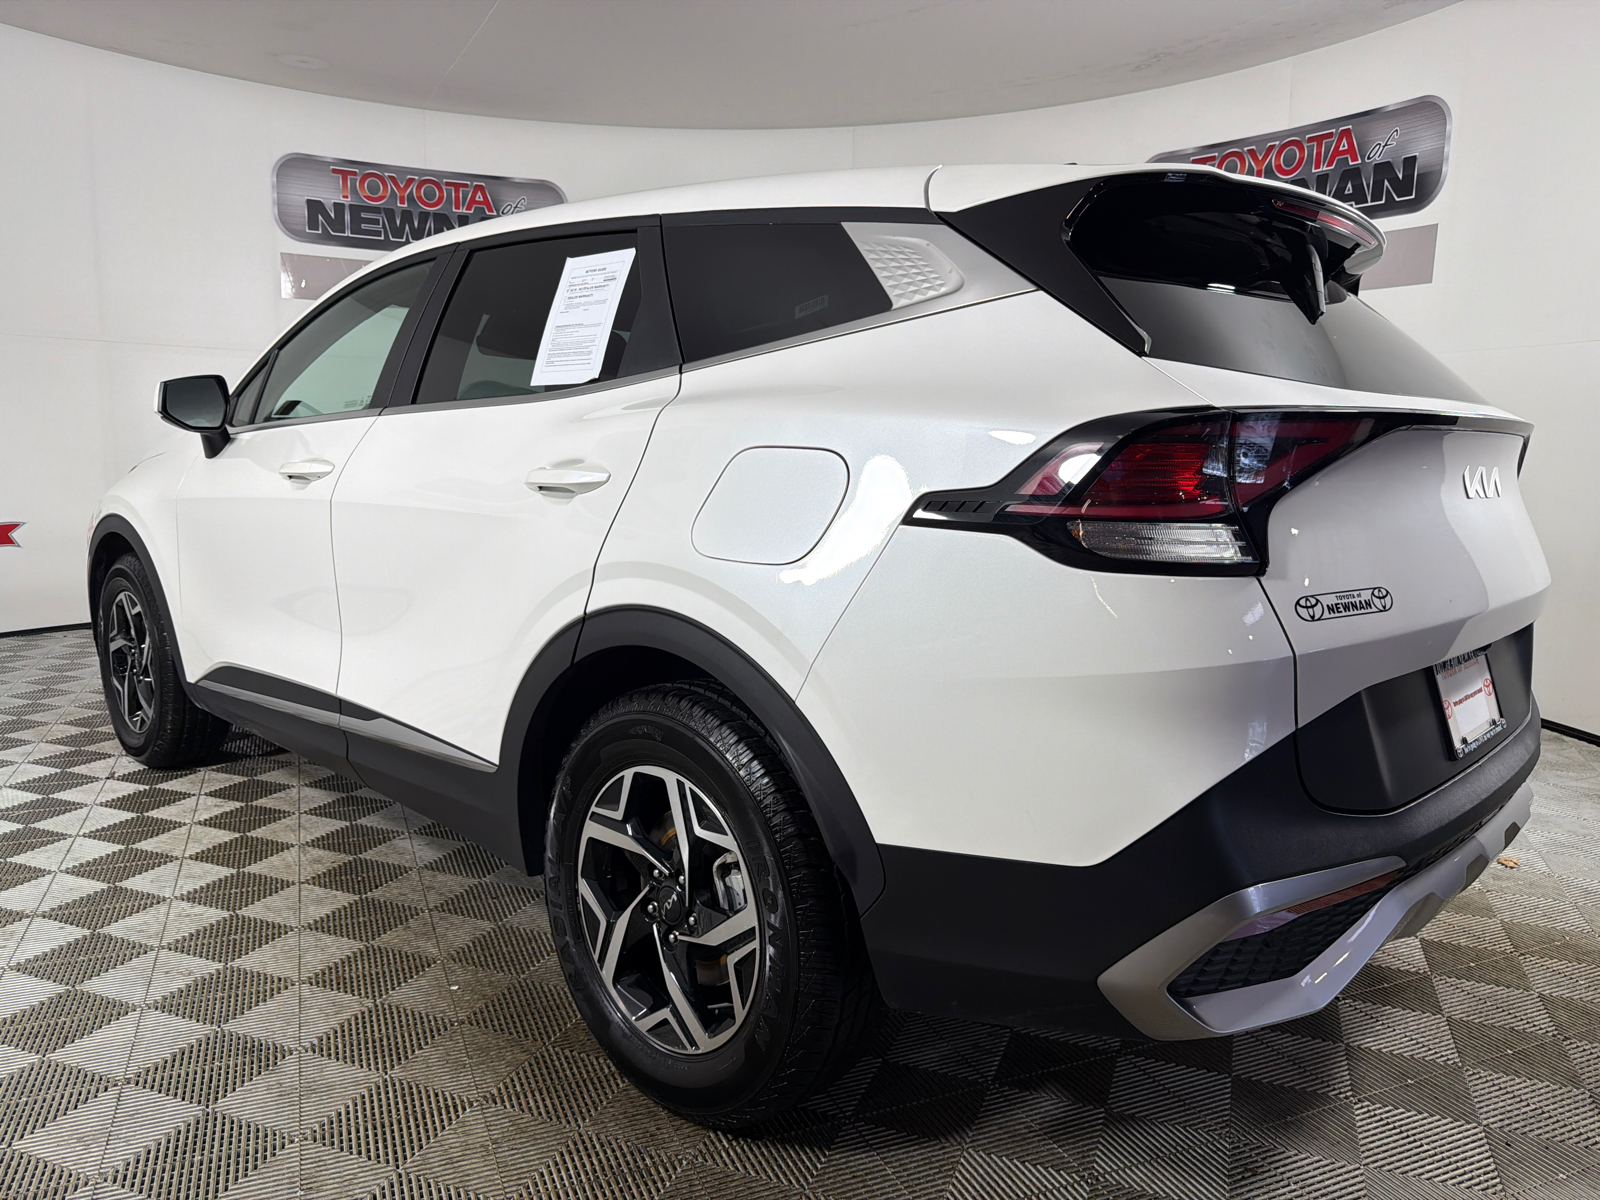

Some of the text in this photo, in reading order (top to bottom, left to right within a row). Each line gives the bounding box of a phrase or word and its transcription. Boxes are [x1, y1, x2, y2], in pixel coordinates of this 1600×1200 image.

[1364, 126, 1400, 163] of
[330, 165, 497, 215] TOYOTA
[1326, 598, 1373, 615] NEWNAN
[1334, 593, 1356, 601] TOYOTA
